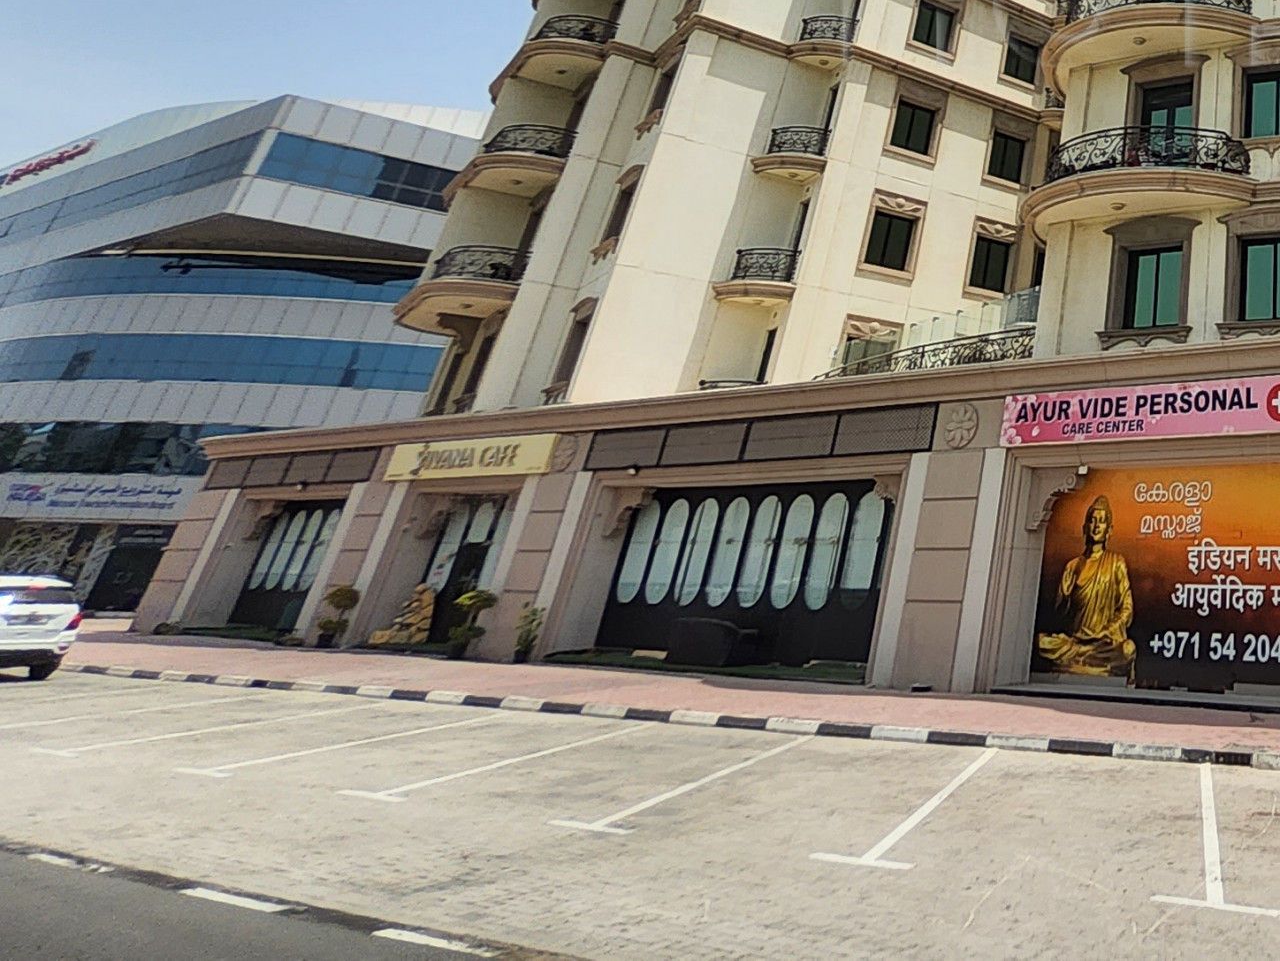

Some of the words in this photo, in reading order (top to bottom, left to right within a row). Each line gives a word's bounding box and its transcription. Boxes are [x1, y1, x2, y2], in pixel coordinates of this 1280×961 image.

[1015, 400, 1071, 424] AYUR
[1078, 395, 1128, 419] VIDE
[1135, 386, 1258, 416] PERSONAL
[1062, 422, 1093, 436] CARE
[1096, 418, 1144, 434] CENTER
[1187, 537, 1252, 575] इंडियन
[1150, 631, 1200, 660] +971
[1209, 633, 1236, 660] 54
